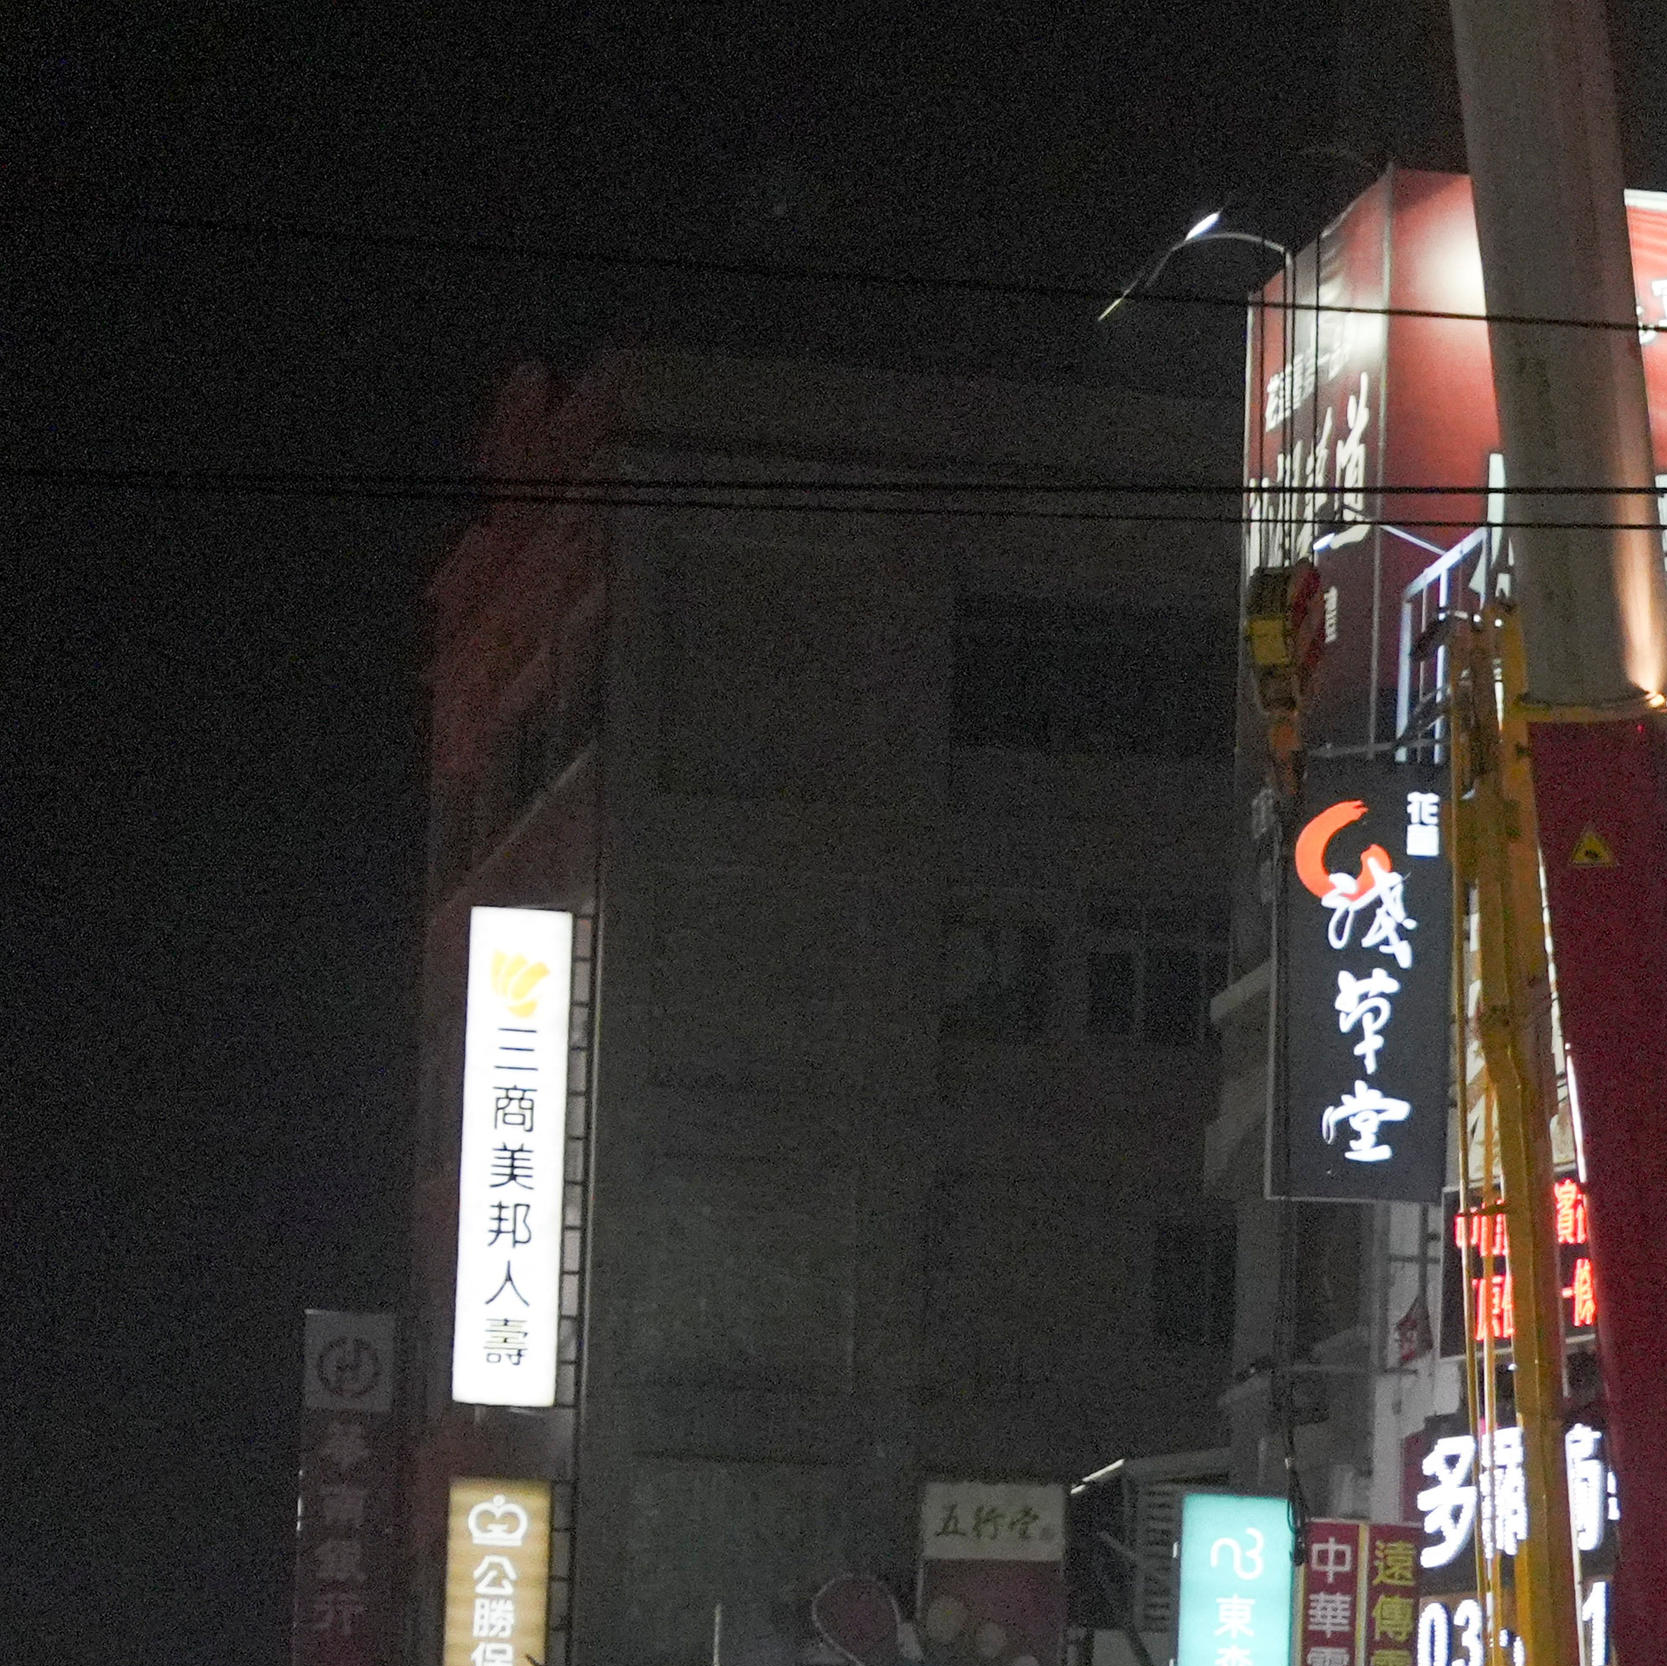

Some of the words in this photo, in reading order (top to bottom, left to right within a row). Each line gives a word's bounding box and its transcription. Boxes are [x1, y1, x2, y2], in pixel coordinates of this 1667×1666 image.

[483, 1027, 540, 1367] 三商美邦人壽
